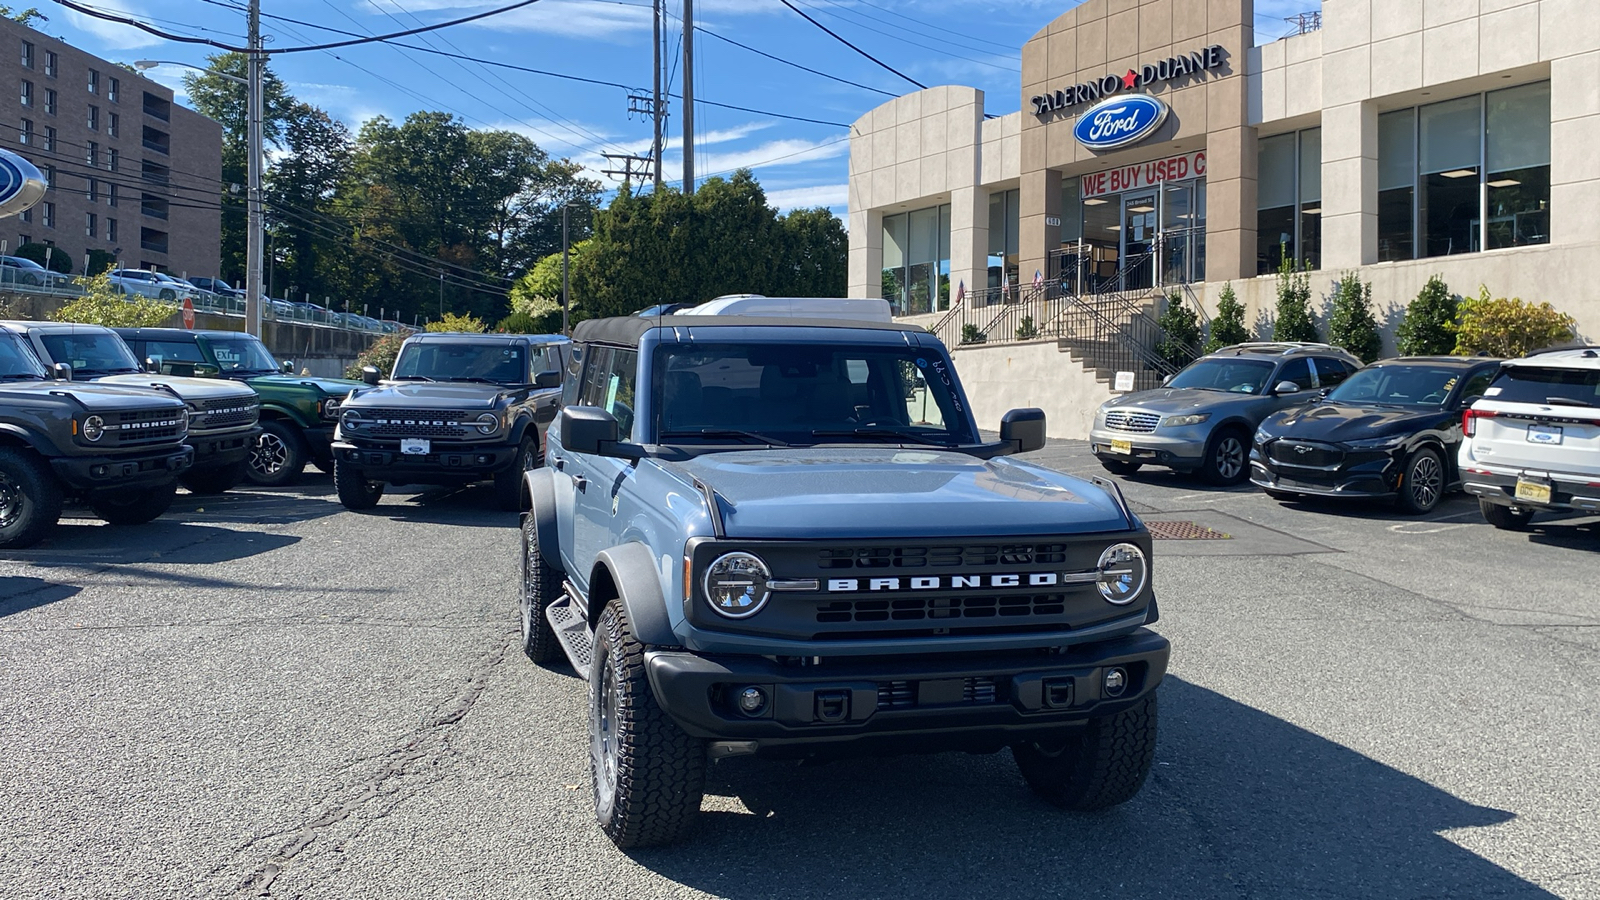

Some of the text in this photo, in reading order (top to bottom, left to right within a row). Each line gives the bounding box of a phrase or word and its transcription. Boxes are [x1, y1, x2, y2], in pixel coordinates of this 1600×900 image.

[1030, 45, 1222, 116] SALERNO DUANE
[1089, 106, 1139, 140] Ford
[1083, 152, 1206, 196] WE BUY USED C
[183, 308, 194, 320] STOP
[216, 351, 235, 360] EXIT
[207, 406, 250, 415] BRONCO
[121, 420, 176, 430] BRONCO
[828, 572, 1057, 592] BRONCO
